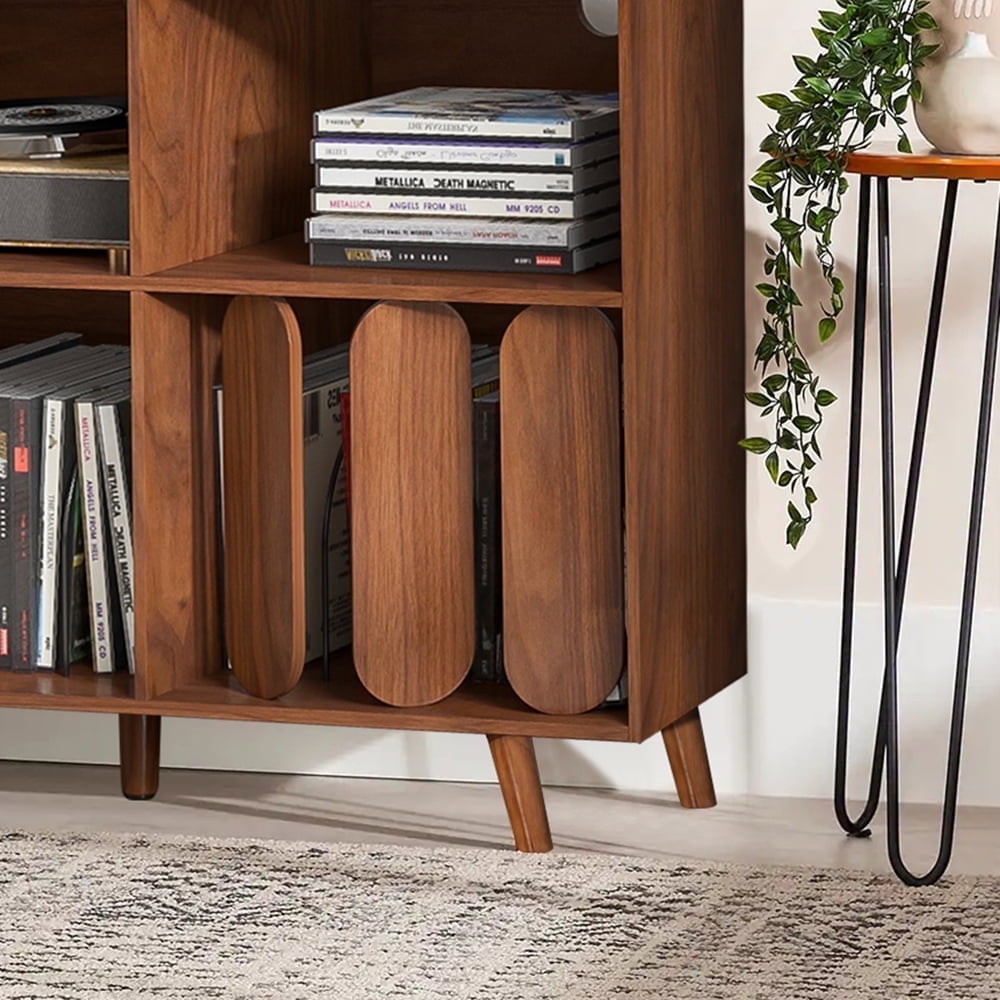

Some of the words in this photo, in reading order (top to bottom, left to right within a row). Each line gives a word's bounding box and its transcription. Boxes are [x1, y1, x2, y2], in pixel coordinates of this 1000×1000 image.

[375, 176, 424, 188] METALLICA
[433, 178, 464, 189] DEATH
[466, 179, 515, 191] MAGNETIC
[329, 200, 371, 209] METALLICA
[389, 202, 420, 210] ANGELS
[424, 202, 446, 210] FROM
[450, 203, 467, 211] HELL
[506, 204, 520, 213] MM
[525, 205, 543, 214] 9205
[547, 206, 560, 214] CD
[82, 417, 91, 462] METALLICA
[86, 480, 95, 512] ANGELS
[107, 464, 121, 518] METALLICA
[89, 515, 97, 539] FROM
[114, 526, 127, 559] DEATH
[119, 562, 133, 613] MAGNETIC
[96, 602, 103, 617] MM
[98, 645, 107, 659] CD
